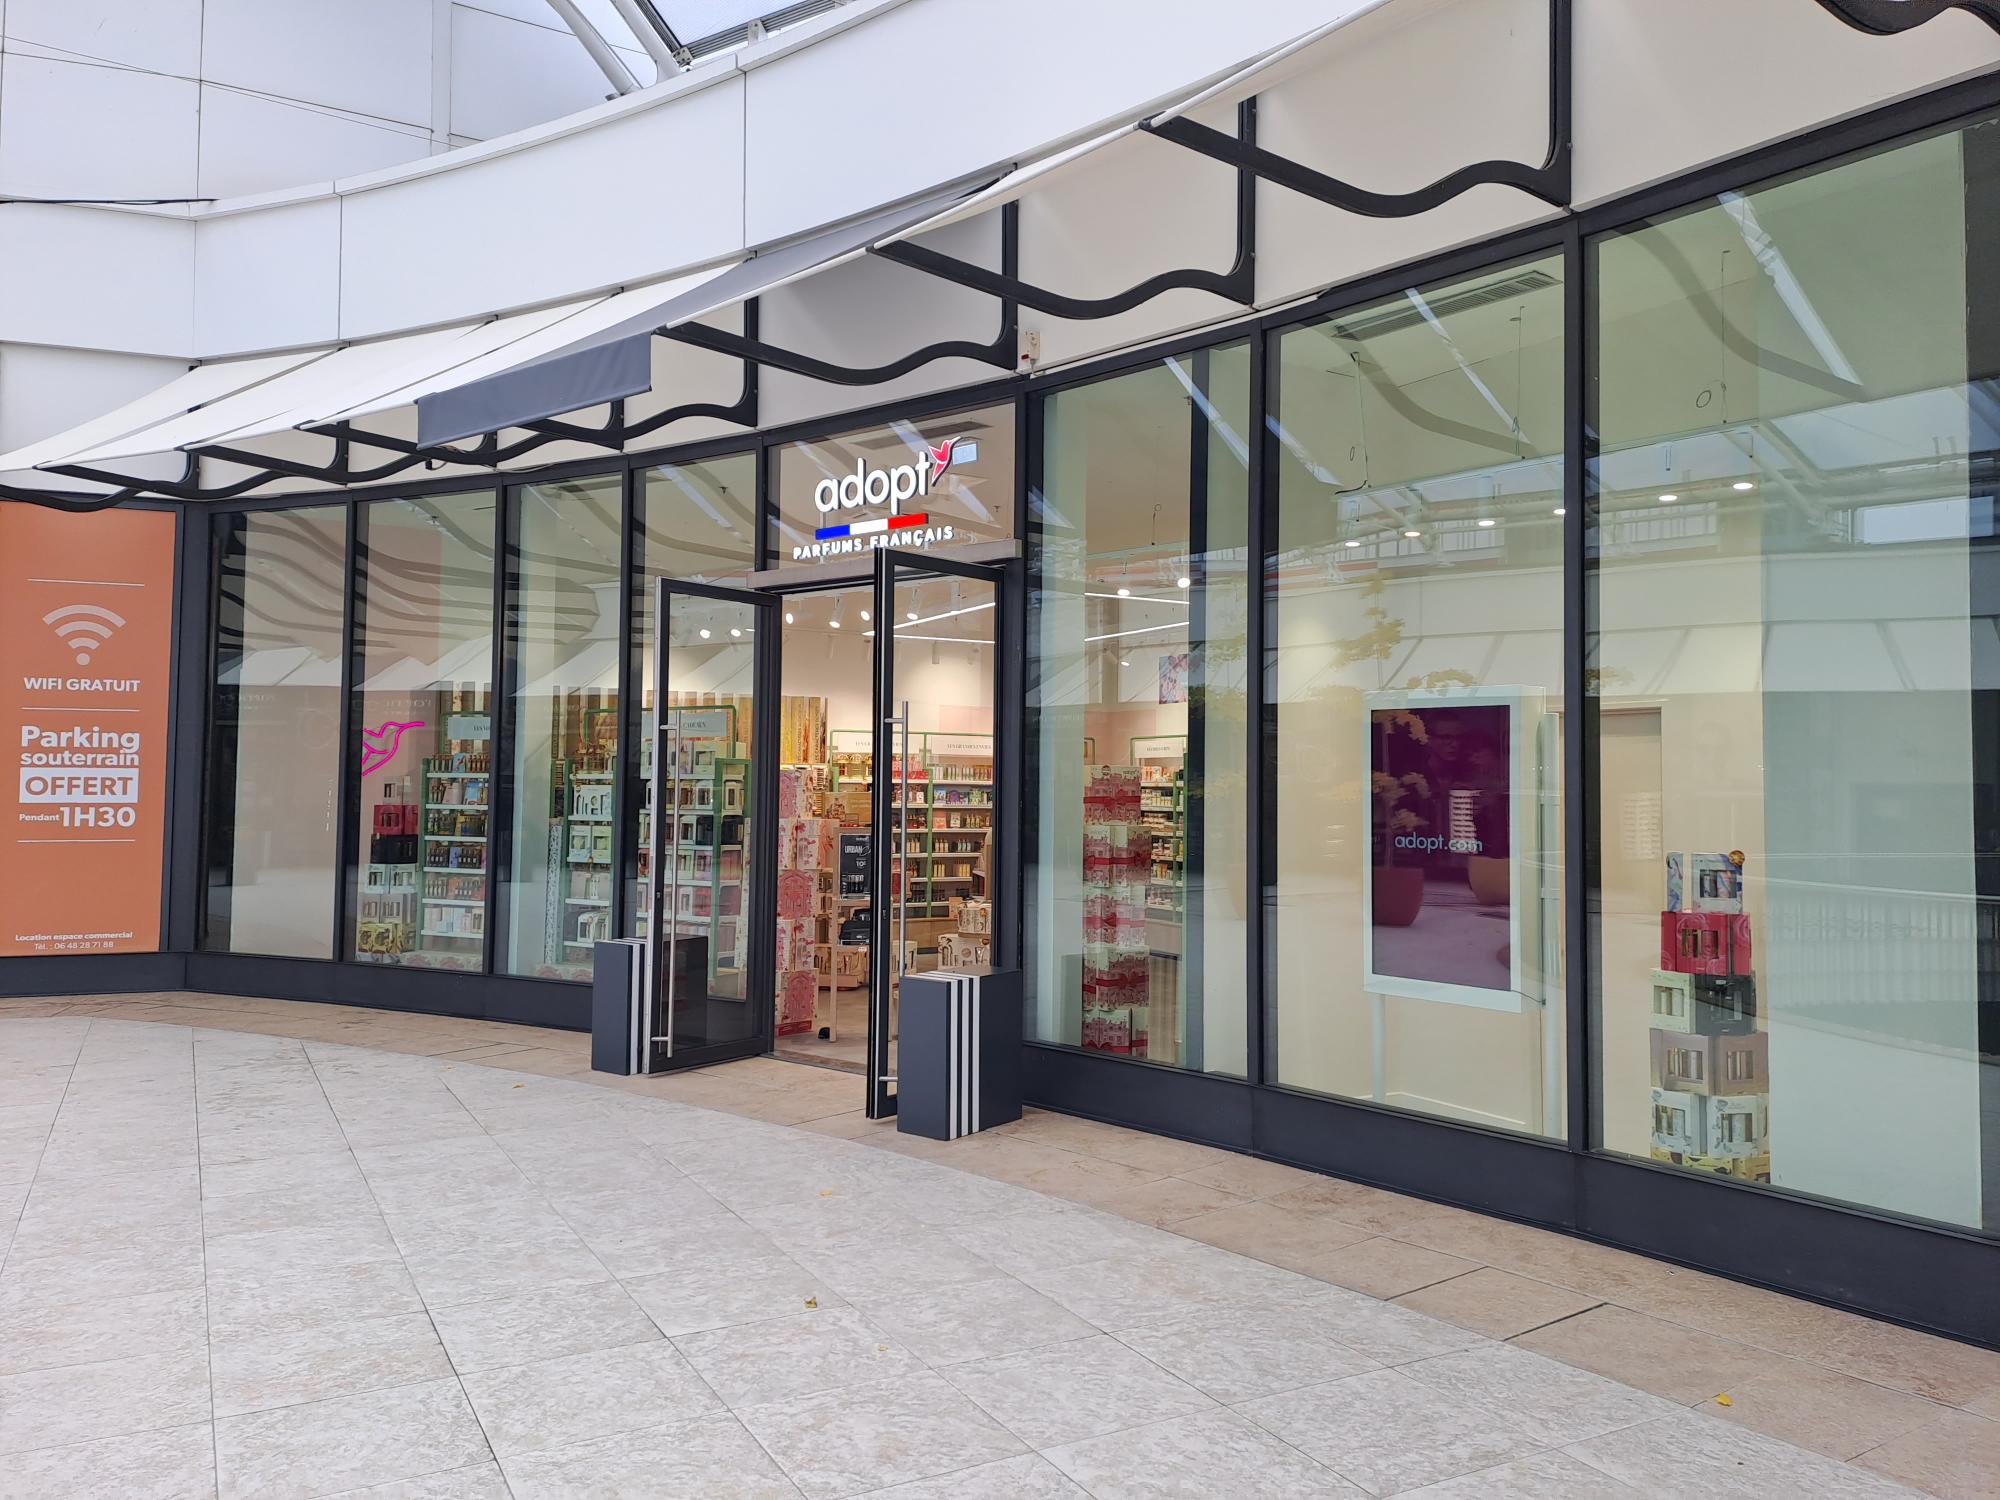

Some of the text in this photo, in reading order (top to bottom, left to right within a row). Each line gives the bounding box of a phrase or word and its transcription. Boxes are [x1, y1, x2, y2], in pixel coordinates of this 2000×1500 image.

[814, 451, 932, 515] adopt
[792, 525, 955, 560] PARFUMS FRANÇAIS
[24, 677, 141, 692] WIFI GRATUIT
[20, 725, 141, 754] Parking
[20, 749, 140, 767] souterrain
[25, 775, 134, 796] OFFERT
[19, 806, 136, 828] Pendant 1H30
[1394, 831, 1483, 854] adopt.com
[15, 931, 133, 942] Location espace commercial
[67, 942, 78, 950] 48
